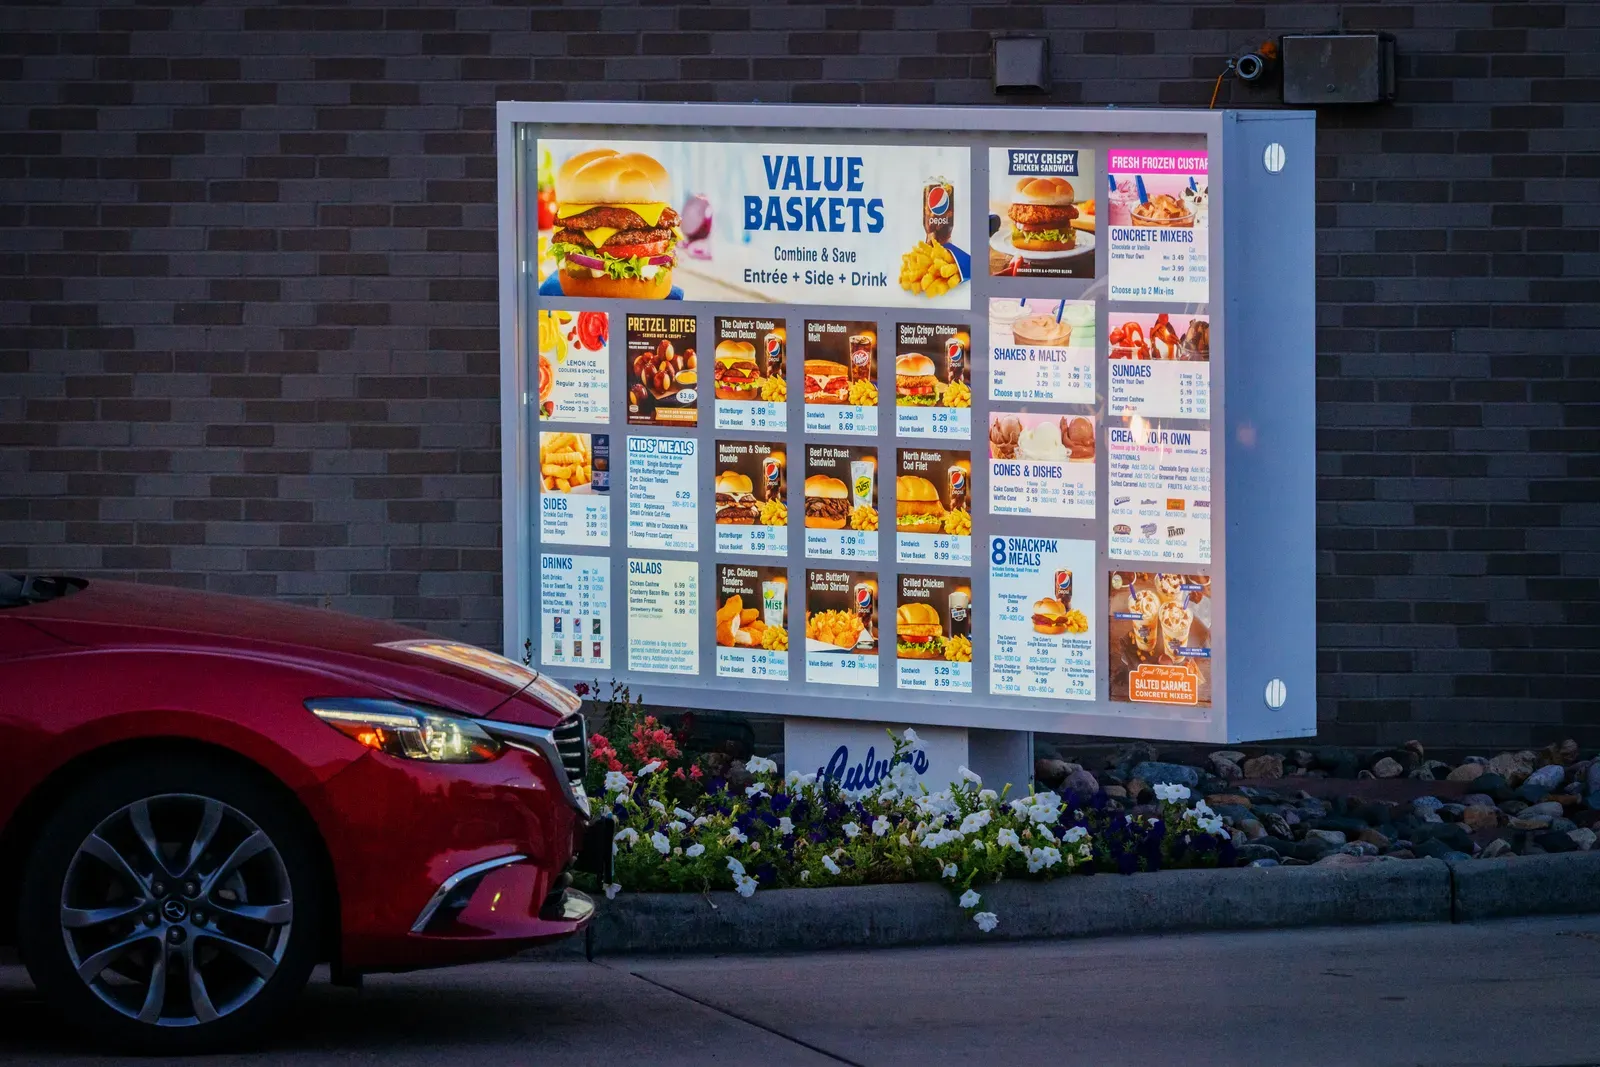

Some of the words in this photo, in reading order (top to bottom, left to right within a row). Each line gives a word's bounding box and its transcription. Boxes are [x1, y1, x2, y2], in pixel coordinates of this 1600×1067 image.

[1013, 153, 1040, 164] SPICY
[1041, 153, 1074, 165] CRISPY
[1112, 156, 1139, 168] FRESH
[1142, 157, 1175, 169] FROZEN
[1013, 163, 1039, 172] CHICKEN
[1041, 164, 1074, 173] SANDWICH
[763, 155, 864, 192] VALUE
[743, 195, 885, 234] BASKETS
[1112, 229, 1157, 242] CONCRETE
[1160, 230, 1193, 242] MIXERS
[774, 246, 817, 263] Combine
[820, 248, 828, 262] &
[832, 248, 856, 263] Save
[743, 268, 788, 285] Entrée
[794, 274, 800, 284] +
[805, 270, 834, 285] Side
[839, 275, 845, 285] +
[851, 271, 887, 287] Drink
[1111, 286, 1132, 294] Choose
[1148, 287, 1152, 295] 2
[1153, 287, 1174, 295] Mix-ins
[628, 317, 667, 332] PRETZEL
[670, 319, 696, 332] BITES
[721, 320, 732, 328] The
[756, 321, 774, 329] Double
[808, 324, 825, 332] Grilled
[827, 324, 846, 332] Reuben
[721, 330, 737, 338] Bacon
[739, 331, 756, 339] Deluxe
[900, 325, 915, 335] Spicy
[917, 326, 934, 336] Crispy
[936, 326, 957, 334] Chicken
[808, 333, 820, 342] Melt
[901, 336, 927, 344] Sandwich
[994, 348, 1026, 360] SHAKES
[1030, 349, 1035, 361] &
[1039, 350, 1066, 362] MALTS
[1112, 365, 1151, 377] SUNDAES
[994, 389, 1012, 397] Choose
[1014, 391, 1020, 399] up
[1034, 390, 1053, 398] Mix-ins
[1171, 433, 1191, 445] OWN
[629, 438, 657, 453] KIDS'
[659, 440, 693, 455] MEALS
[720, 445, 747, 453] Mushroom
[754, 446, 770, 454] Swiss
[720, 454, 738, 462] Double
[810, 448, 822, 457] Beef
[823, 449, 833, 457] Pot
[834, 450, 849, 458] Roast
[903, 451, 919, 460] North
[920, 452, 941, 461] Atlantic
[810, 458, 835, 466] Sandwich
[903, 461, 914, 470] Cod
[915, 462, 927, 470] Filet
[994, 464, 1020, 476] CONES
[1024, 465, 1029, 477] &
[1033, 466, 1062, 478] DISHES
[544, 498, 567, 510] SIDES
[934, 540, 948, 548] 5.69
[841, 548, 855, 556] 8.39
[992, 538, 1006, 565] 8
[1009, 538, 1057, 553] SNACKPAK
[543, 557, 572, 569] DRINKS
[1009, 552, 1040, 566] MEALS
[630, 561, 662, 574] SALADS
[722, 567, 725, 575] 4
[737, 568, 758, 577] Chicken
[722, 577, 743, 586] Tenders
[811, 572, 814, 580] 6
[816, 574, 824, 582] pc.
[826, 572, 849, 582] Butterfly
[811, 582, 828, 590] Jumbo
[830, 582, 849, 593] Shrimp
[903, 578, 921, 587] Grilled
[922, 579, 944, 588] Chicken
[903, 588, 930, 597] Sandwich
[765, 600, 782, 610] Mist
[841, 660, 855, 668] 9.29
[1135, 679, 1159, 689] SALTED
[1161, 680, 1192, 691] CARAMEL
